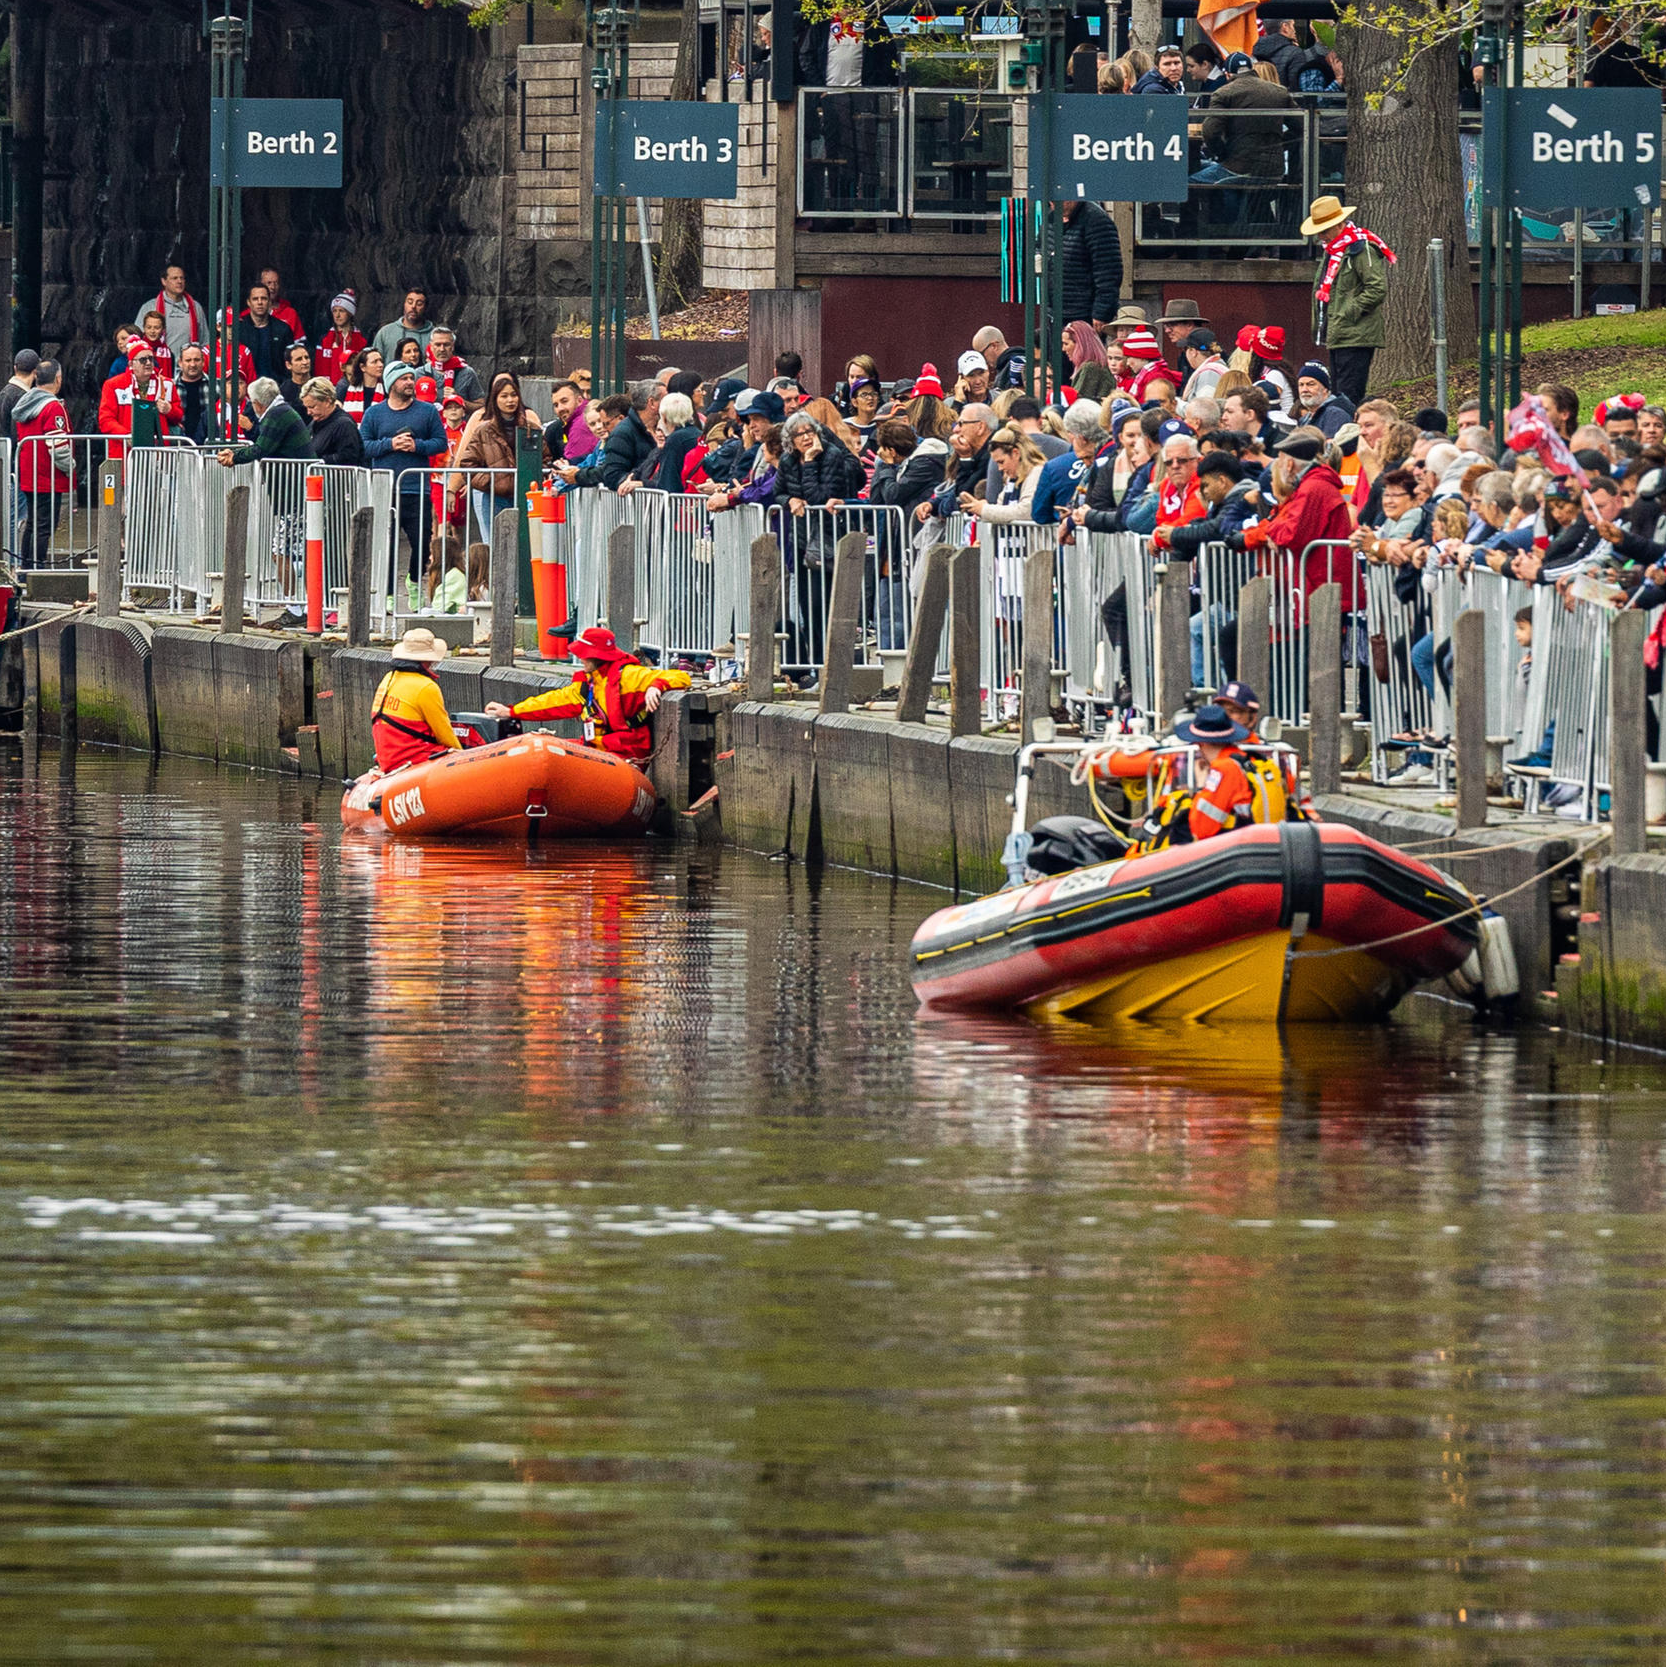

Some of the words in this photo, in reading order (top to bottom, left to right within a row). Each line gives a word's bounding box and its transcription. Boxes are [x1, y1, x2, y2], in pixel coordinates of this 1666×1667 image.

[248, 130, 314, 154] Berth
[323, 132, 338, 154] 2
[634, 135, 707, 162] Berth
[717, 138, 732, 163] 3
[1073, 132, 1154, 162] Berth
[1163, 135, 1183, 161] 4
[1533, 130, 1623, 163] Berth
[1636, 133, 1655, 163] 5
[107, 475, 113, 487] 2
[388, 792, 411, 826] LSV
[406, 786, 426, 818] 123
